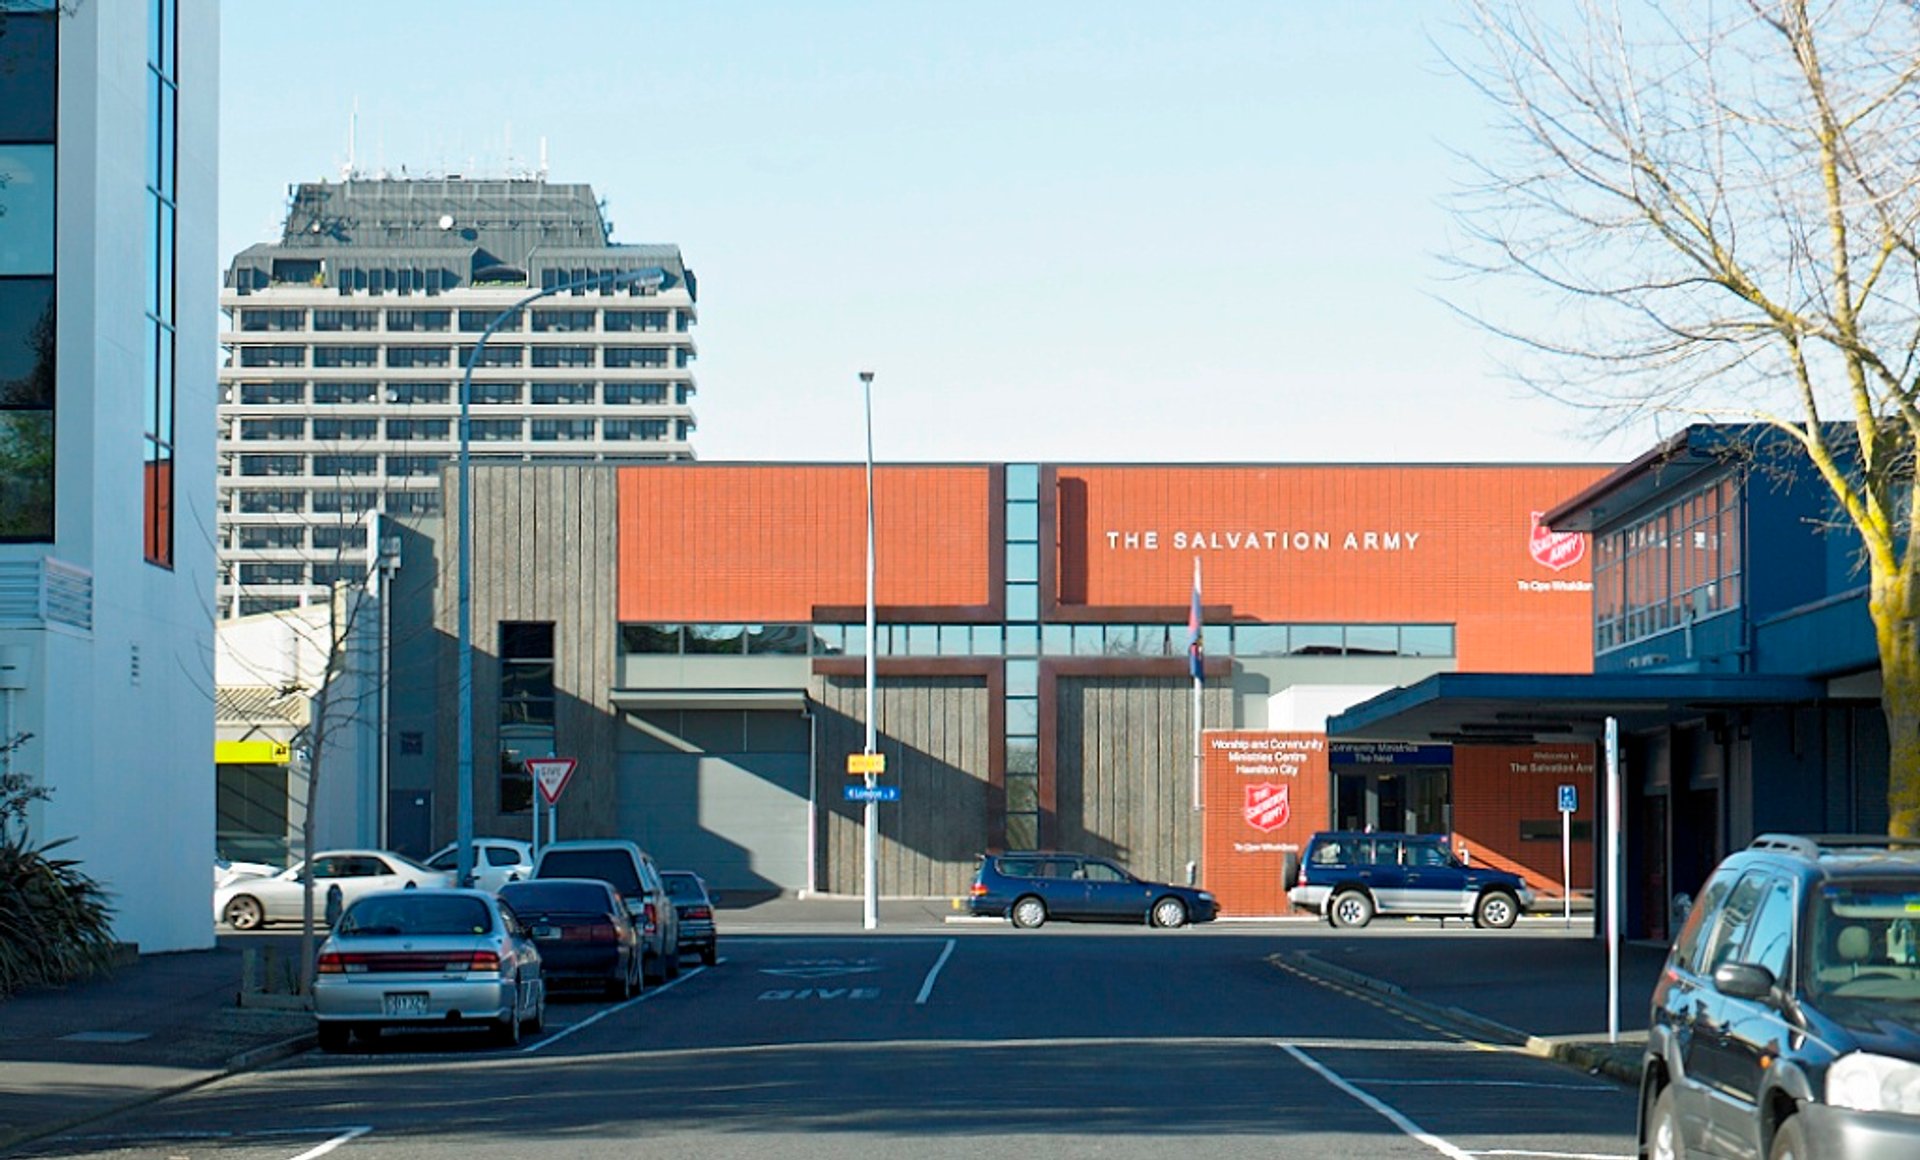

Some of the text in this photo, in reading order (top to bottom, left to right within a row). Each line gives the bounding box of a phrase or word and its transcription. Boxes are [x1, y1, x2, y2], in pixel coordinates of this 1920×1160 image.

[1107, 531, 1420, 549] THE SALVATION ARMY
[1211, 739, 1323, 752] Worship and Community
[1228, 752, 1307, 762] Ministries Centre
[1236, 764, 1298, 776] Hamilton City
[1511, 763, 1528, 772] The
[1530, 763, 1574, 773] Salvation
